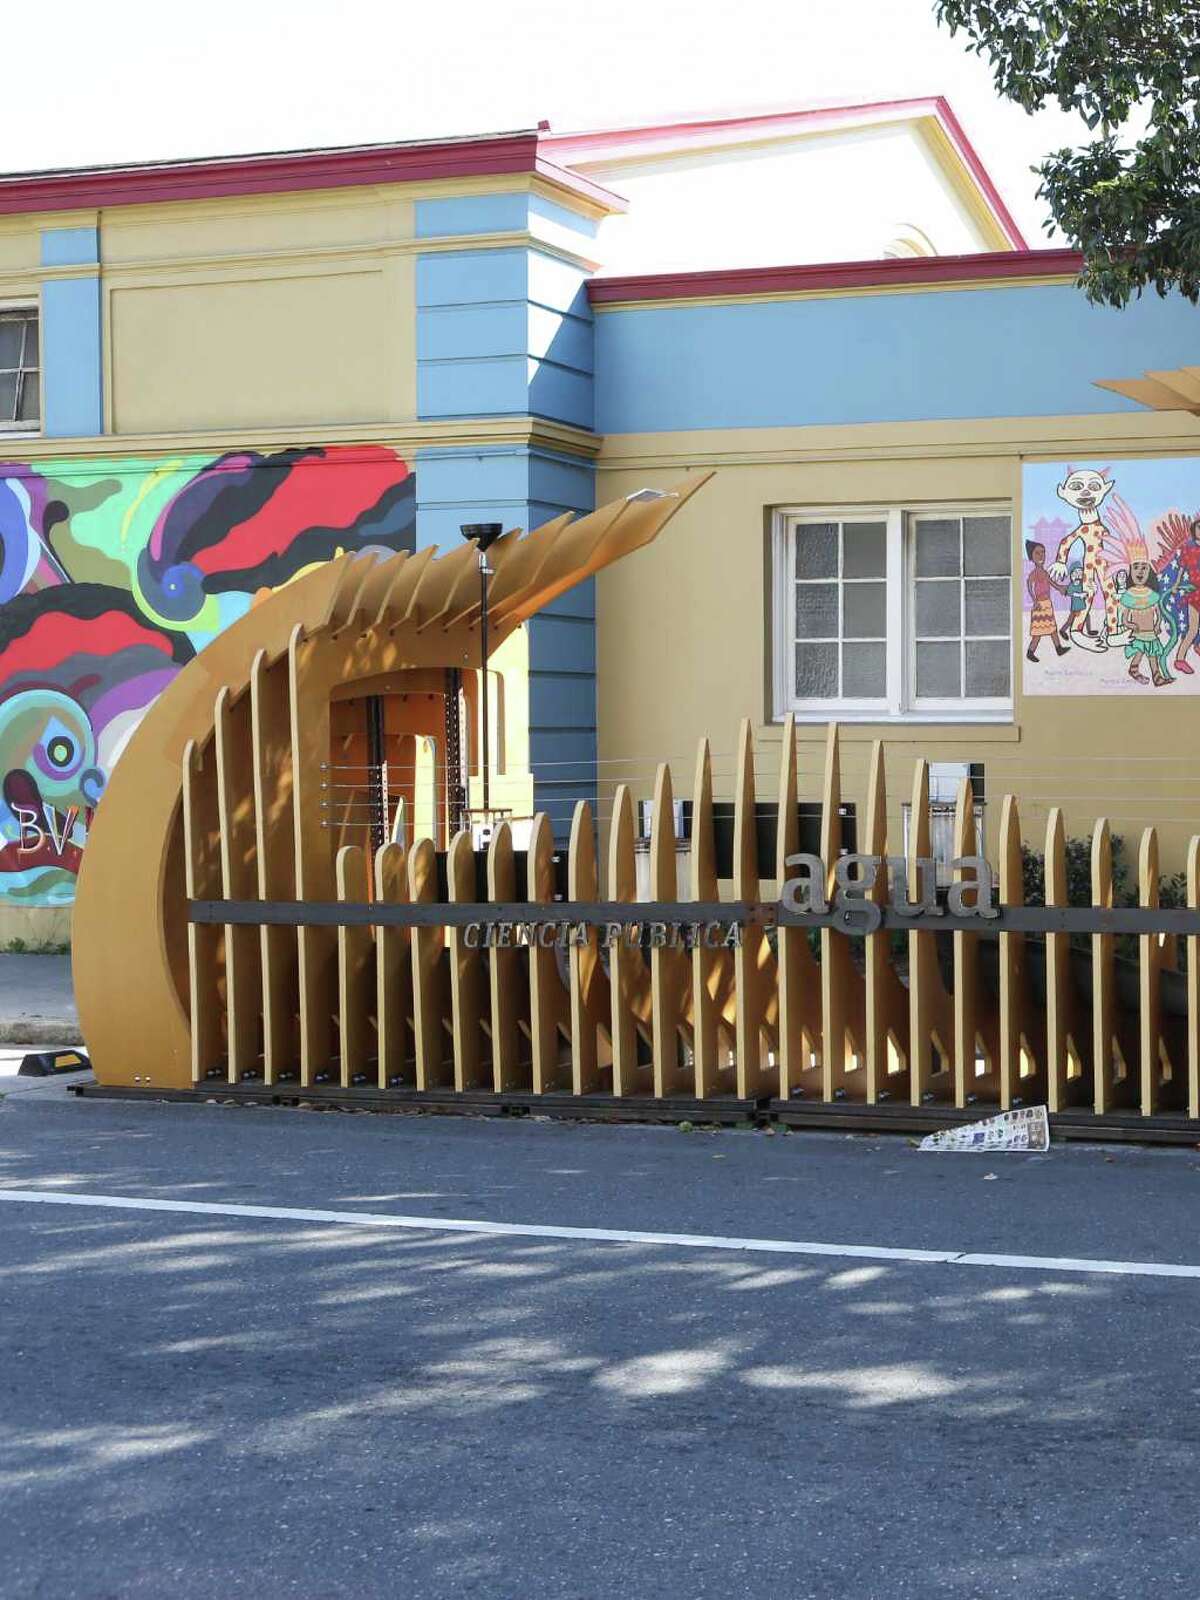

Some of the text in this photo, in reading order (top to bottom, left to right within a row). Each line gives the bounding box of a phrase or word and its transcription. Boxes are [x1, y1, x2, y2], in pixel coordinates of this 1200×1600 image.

[11, 802, 95, 856] BV
[781, 853, 1000, 935] agua
[463, 921, 589, 948] CIENCIA
